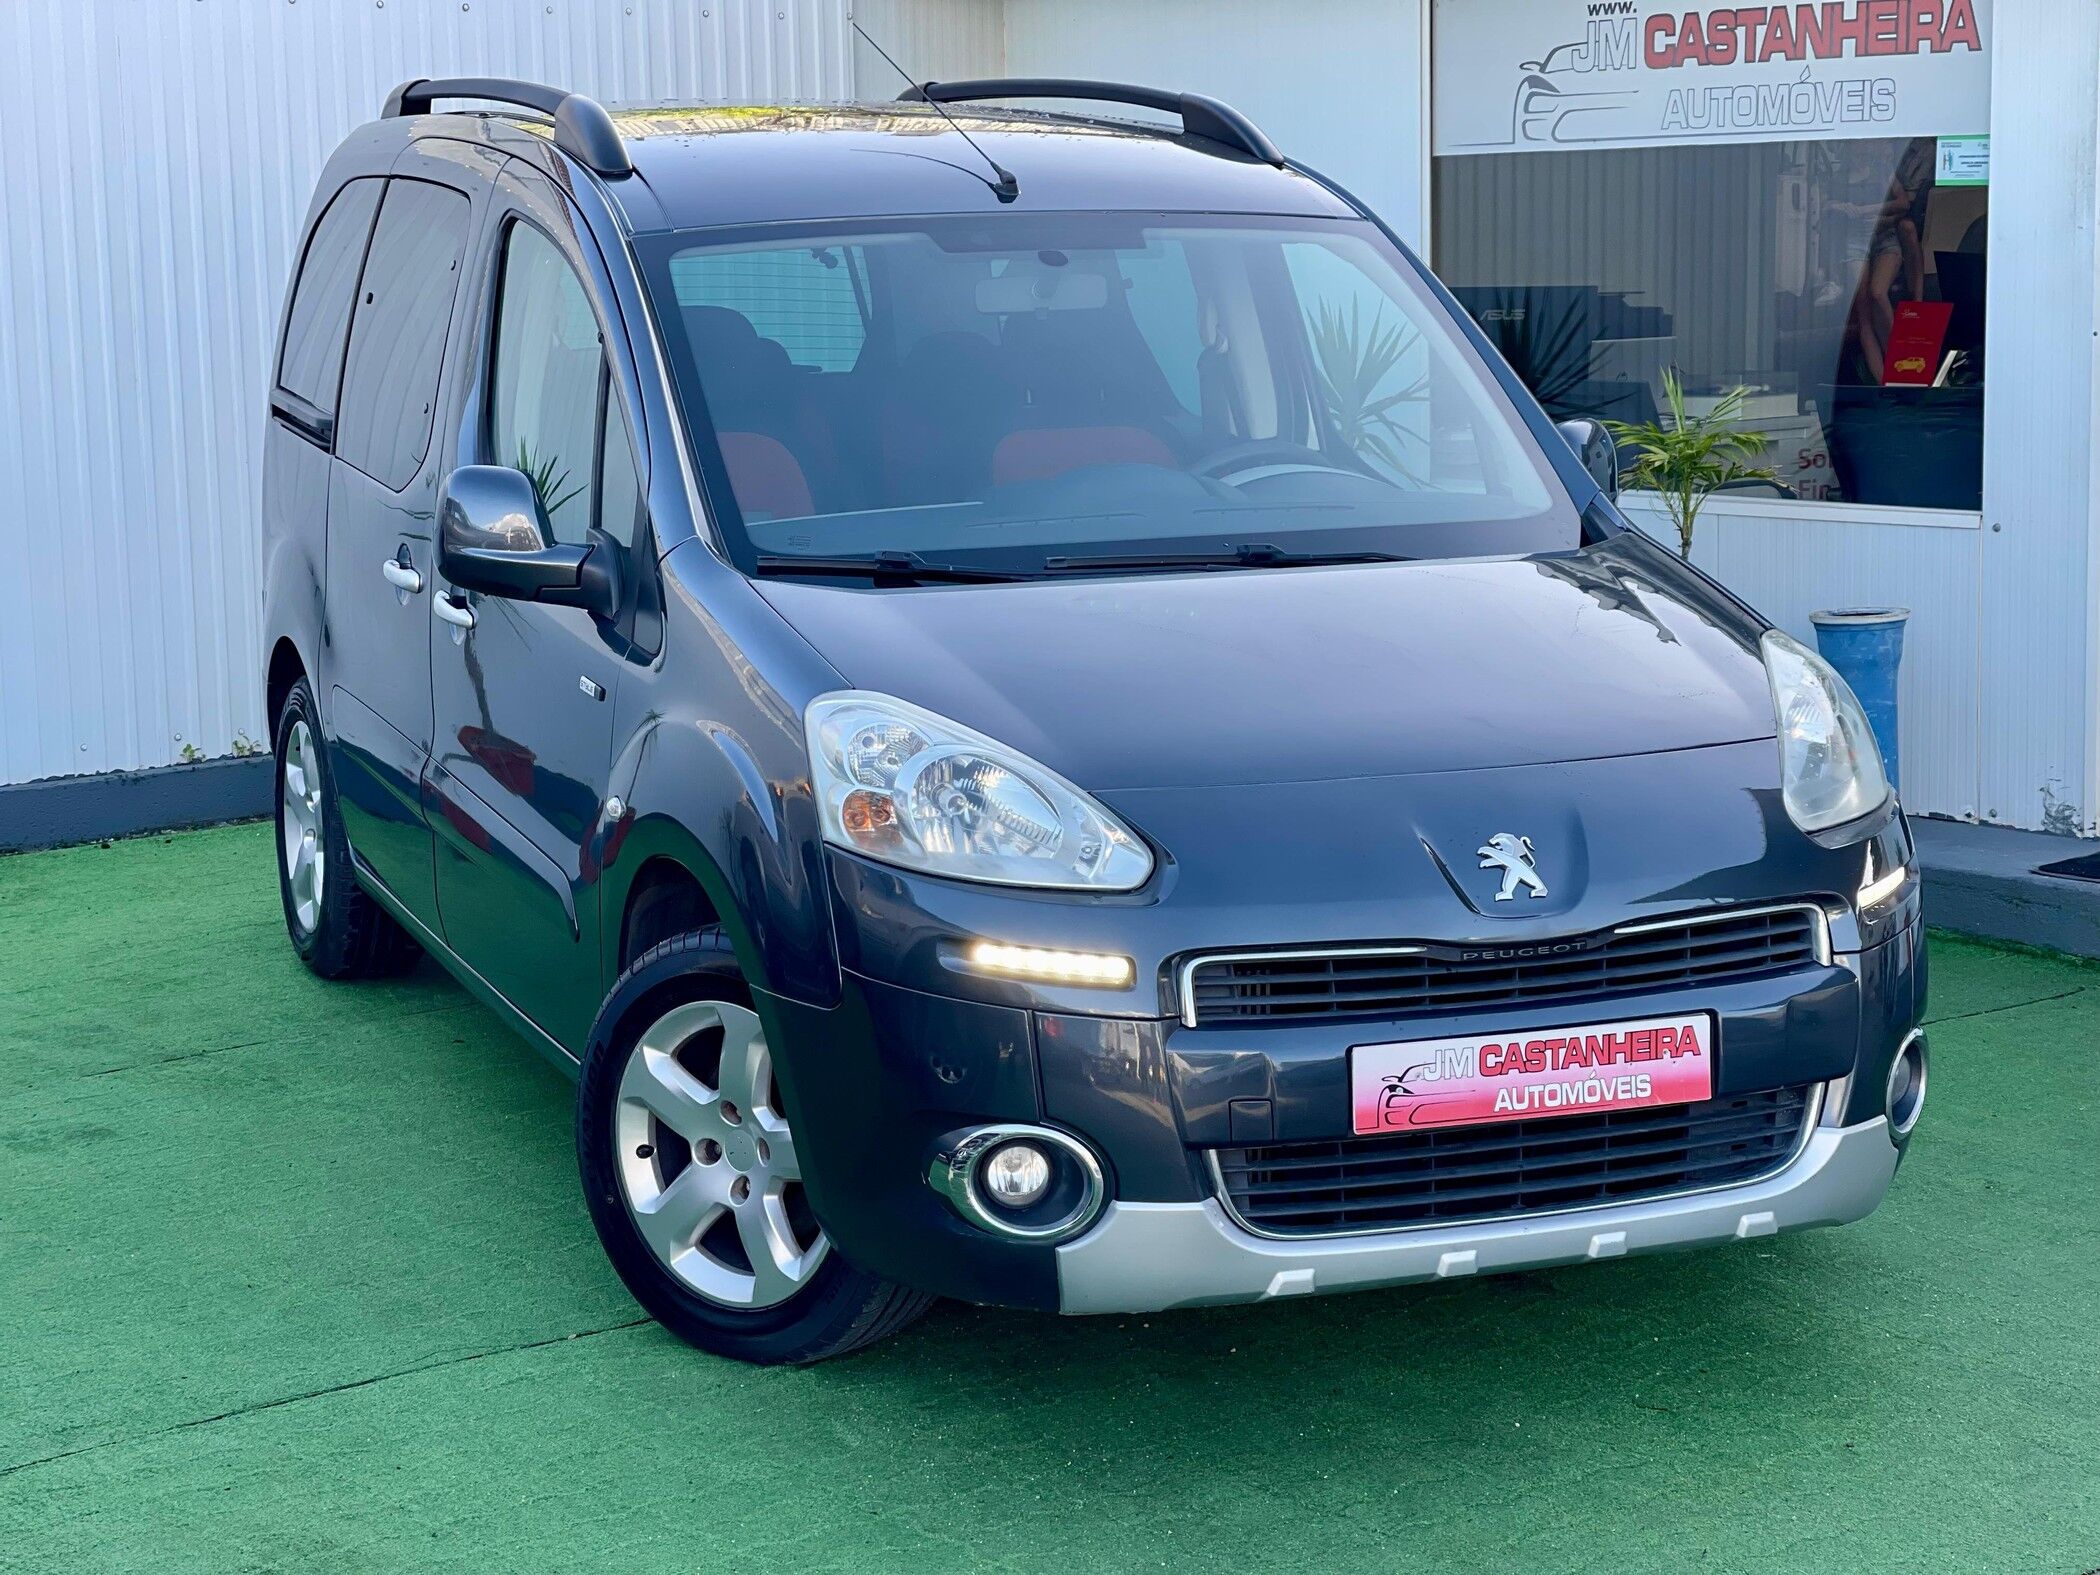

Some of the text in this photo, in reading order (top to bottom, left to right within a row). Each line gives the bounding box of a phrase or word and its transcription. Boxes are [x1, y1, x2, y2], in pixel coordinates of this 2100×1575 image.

[1587, 1, 1637, 16] www.
[1571, 0, 1982, 73] JM CASTANHEIRA
[1661, 65, 1896, 130] AUTOMÓVEIS
[1463, 942, 1586, 960] PEUGEOT
[1422, 1025, 1701, 1082] JM CASTANHEIRA
[1493, 1071, 1652, 1113] AUTOMÓVEIS
